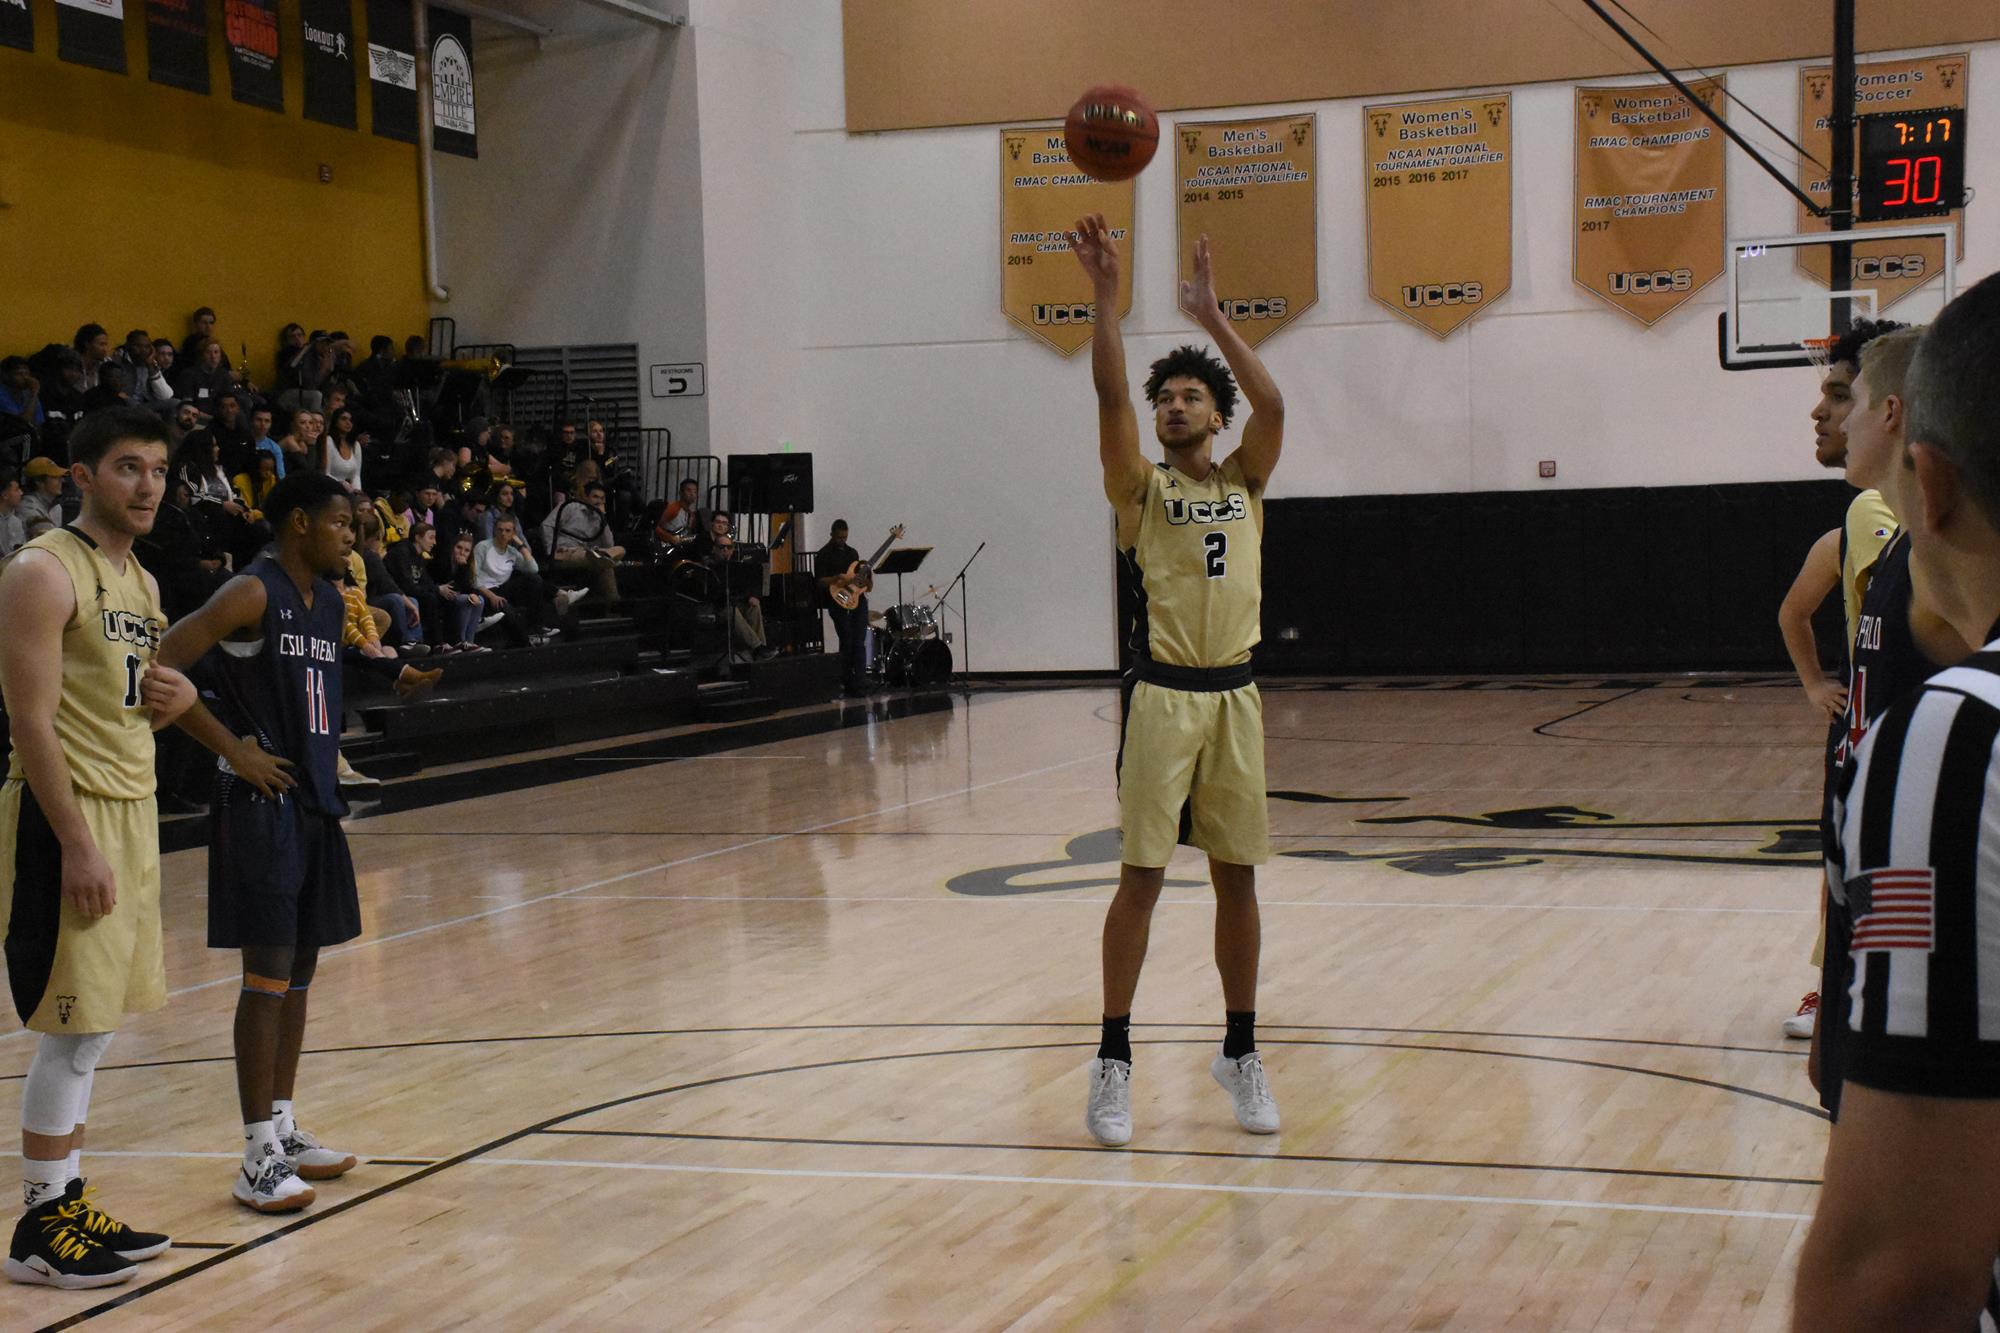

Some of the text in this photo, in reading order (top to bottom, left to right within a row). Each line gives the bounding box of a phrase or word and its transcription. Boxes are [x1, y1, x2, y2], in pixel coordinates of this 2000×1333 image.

[304, 26, 334, 47] LOOKOUT
[1854, 70, 1923, 87] omen's
[433, 74, 473, 106] EMPIRE
[1854, 87, 1912, 102] Soccer
[442, 101, 466, 119] TITLE
[1613, 94, 1686, 109] Women's
[1402, 108, 1472, 125] Women's
[1610, 107, 1690, 124] Basketball
[1223, 129, 1267, 142] Men's
[1400, 123, 1477, 140] Basketball
[1589, 128, 1711, 148] RMAC CHAMPIONS
[1894, 118, 1951, 145] 7:17
[1033, 152, 1072, 164] Baske
[1208, 142, 1283, 158] Basketball
[1388, 143, 1489, 160] NCAA NATIONAL
[1198, 162, 1294, 177] NCAA NATIONAL
[1375, 153, 1504, 171] TOURNAMENT QUALIFIER
[1014, 176, 1048, 187] RMAC
[1184, 172, 1308, 187] TOURNAMENT QUALIFIER
[1373, 169, 1470, 188] 2015 2016 2017
[1882, 155, 1942, 206] 30
[1184, 189, 1244, 203] 2014 2015
[1584, 188, 1716, 208] RMAC TOURNAMENT
[1614, 204, 1686, 217] CHAMPIONS
[1581, 221, 1610, 232] 2017
[1010, 232, 1043, 242] RMAC
[1007, 256, 1033, 266] 2015
[1608, 268, 1693, 295] UCCS
[1402, 281, 1483, 308] UCCS
[1164, 493, 1246, 525] UCCS
[1203, 530, 1228, 578] 2
[101, 609, 160, 651] UCCS
